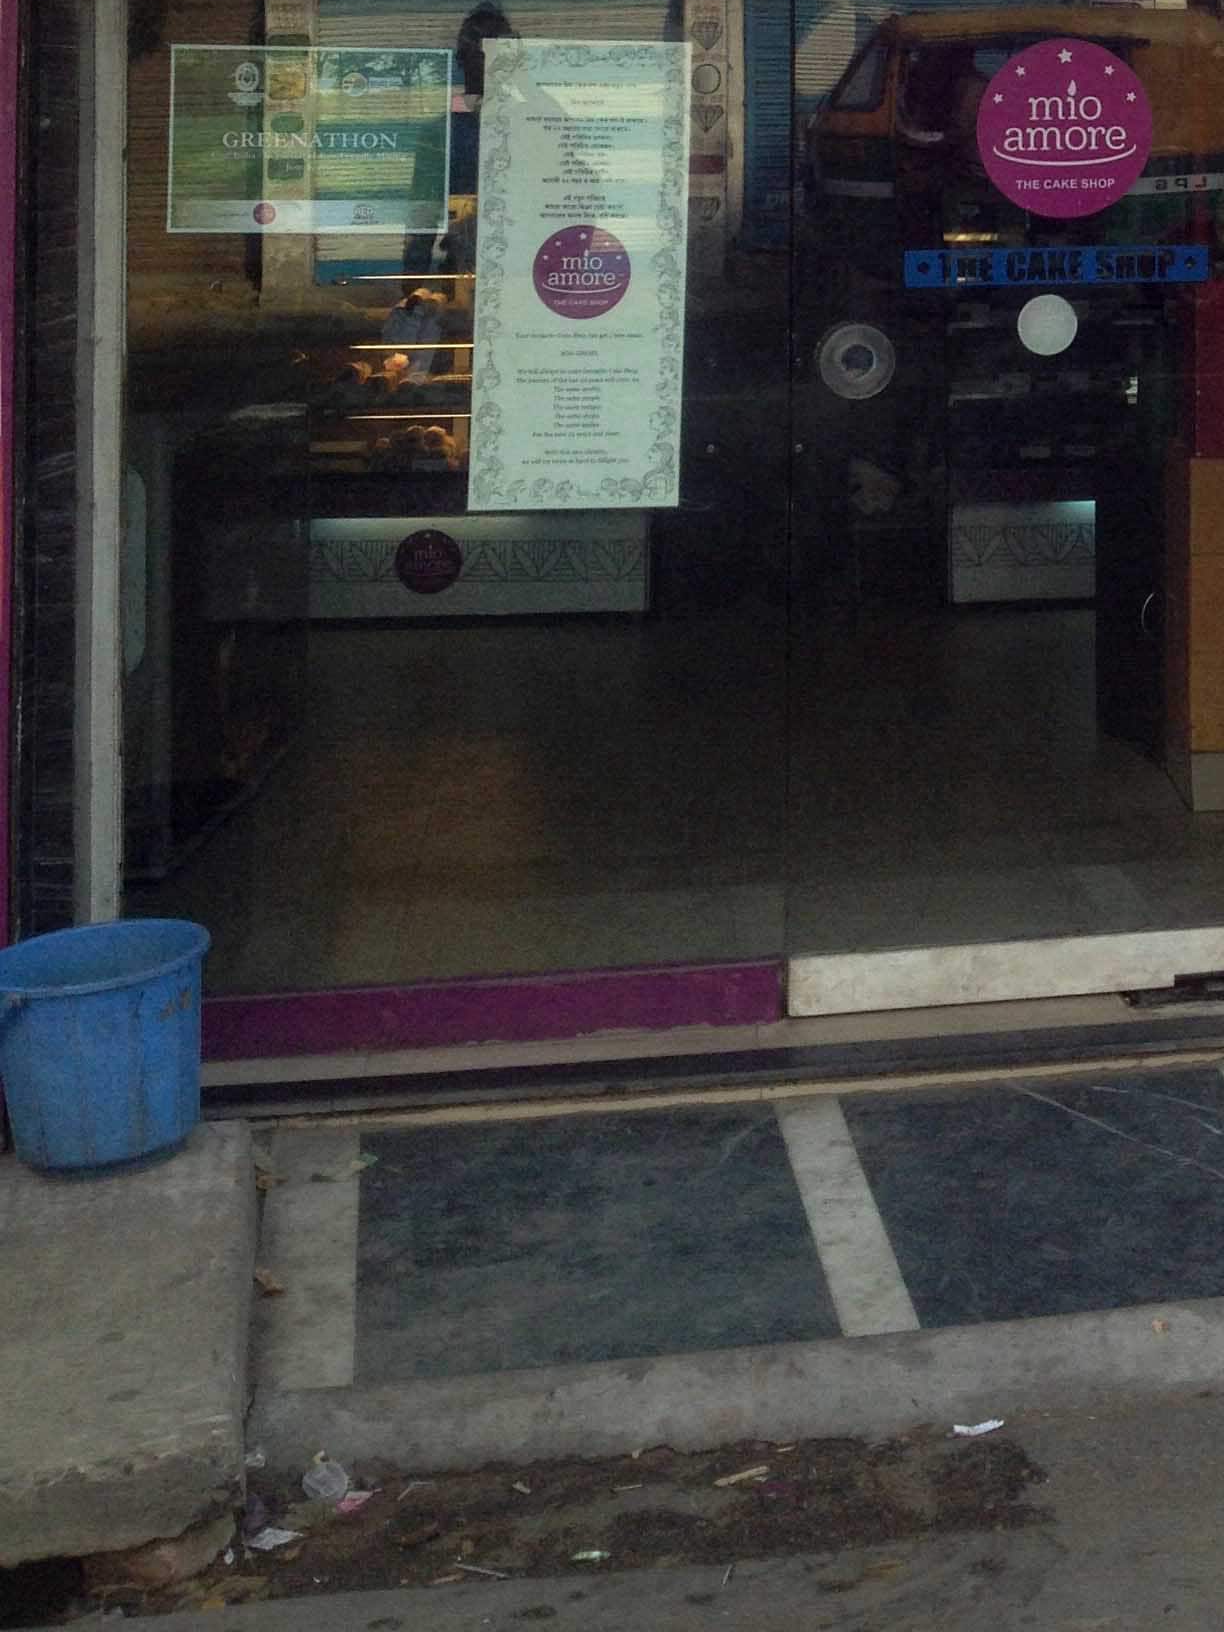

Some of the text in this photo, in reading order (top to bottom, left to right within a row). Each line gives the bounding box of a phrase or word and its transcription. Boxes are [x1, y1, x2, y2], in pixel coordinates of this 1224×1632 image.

[1028, 79, 1102, 122] mio
[222, 131, 399, 150] GREENATHON
[1003, 125, 1128, 152] amore
[1016, 178, 1116, 191] THE CAKE SHOP
[561, 249, 603, 270] mio
[1006, 250, 1083, 281] CAKE
[548, 272, 616, 286] amore
